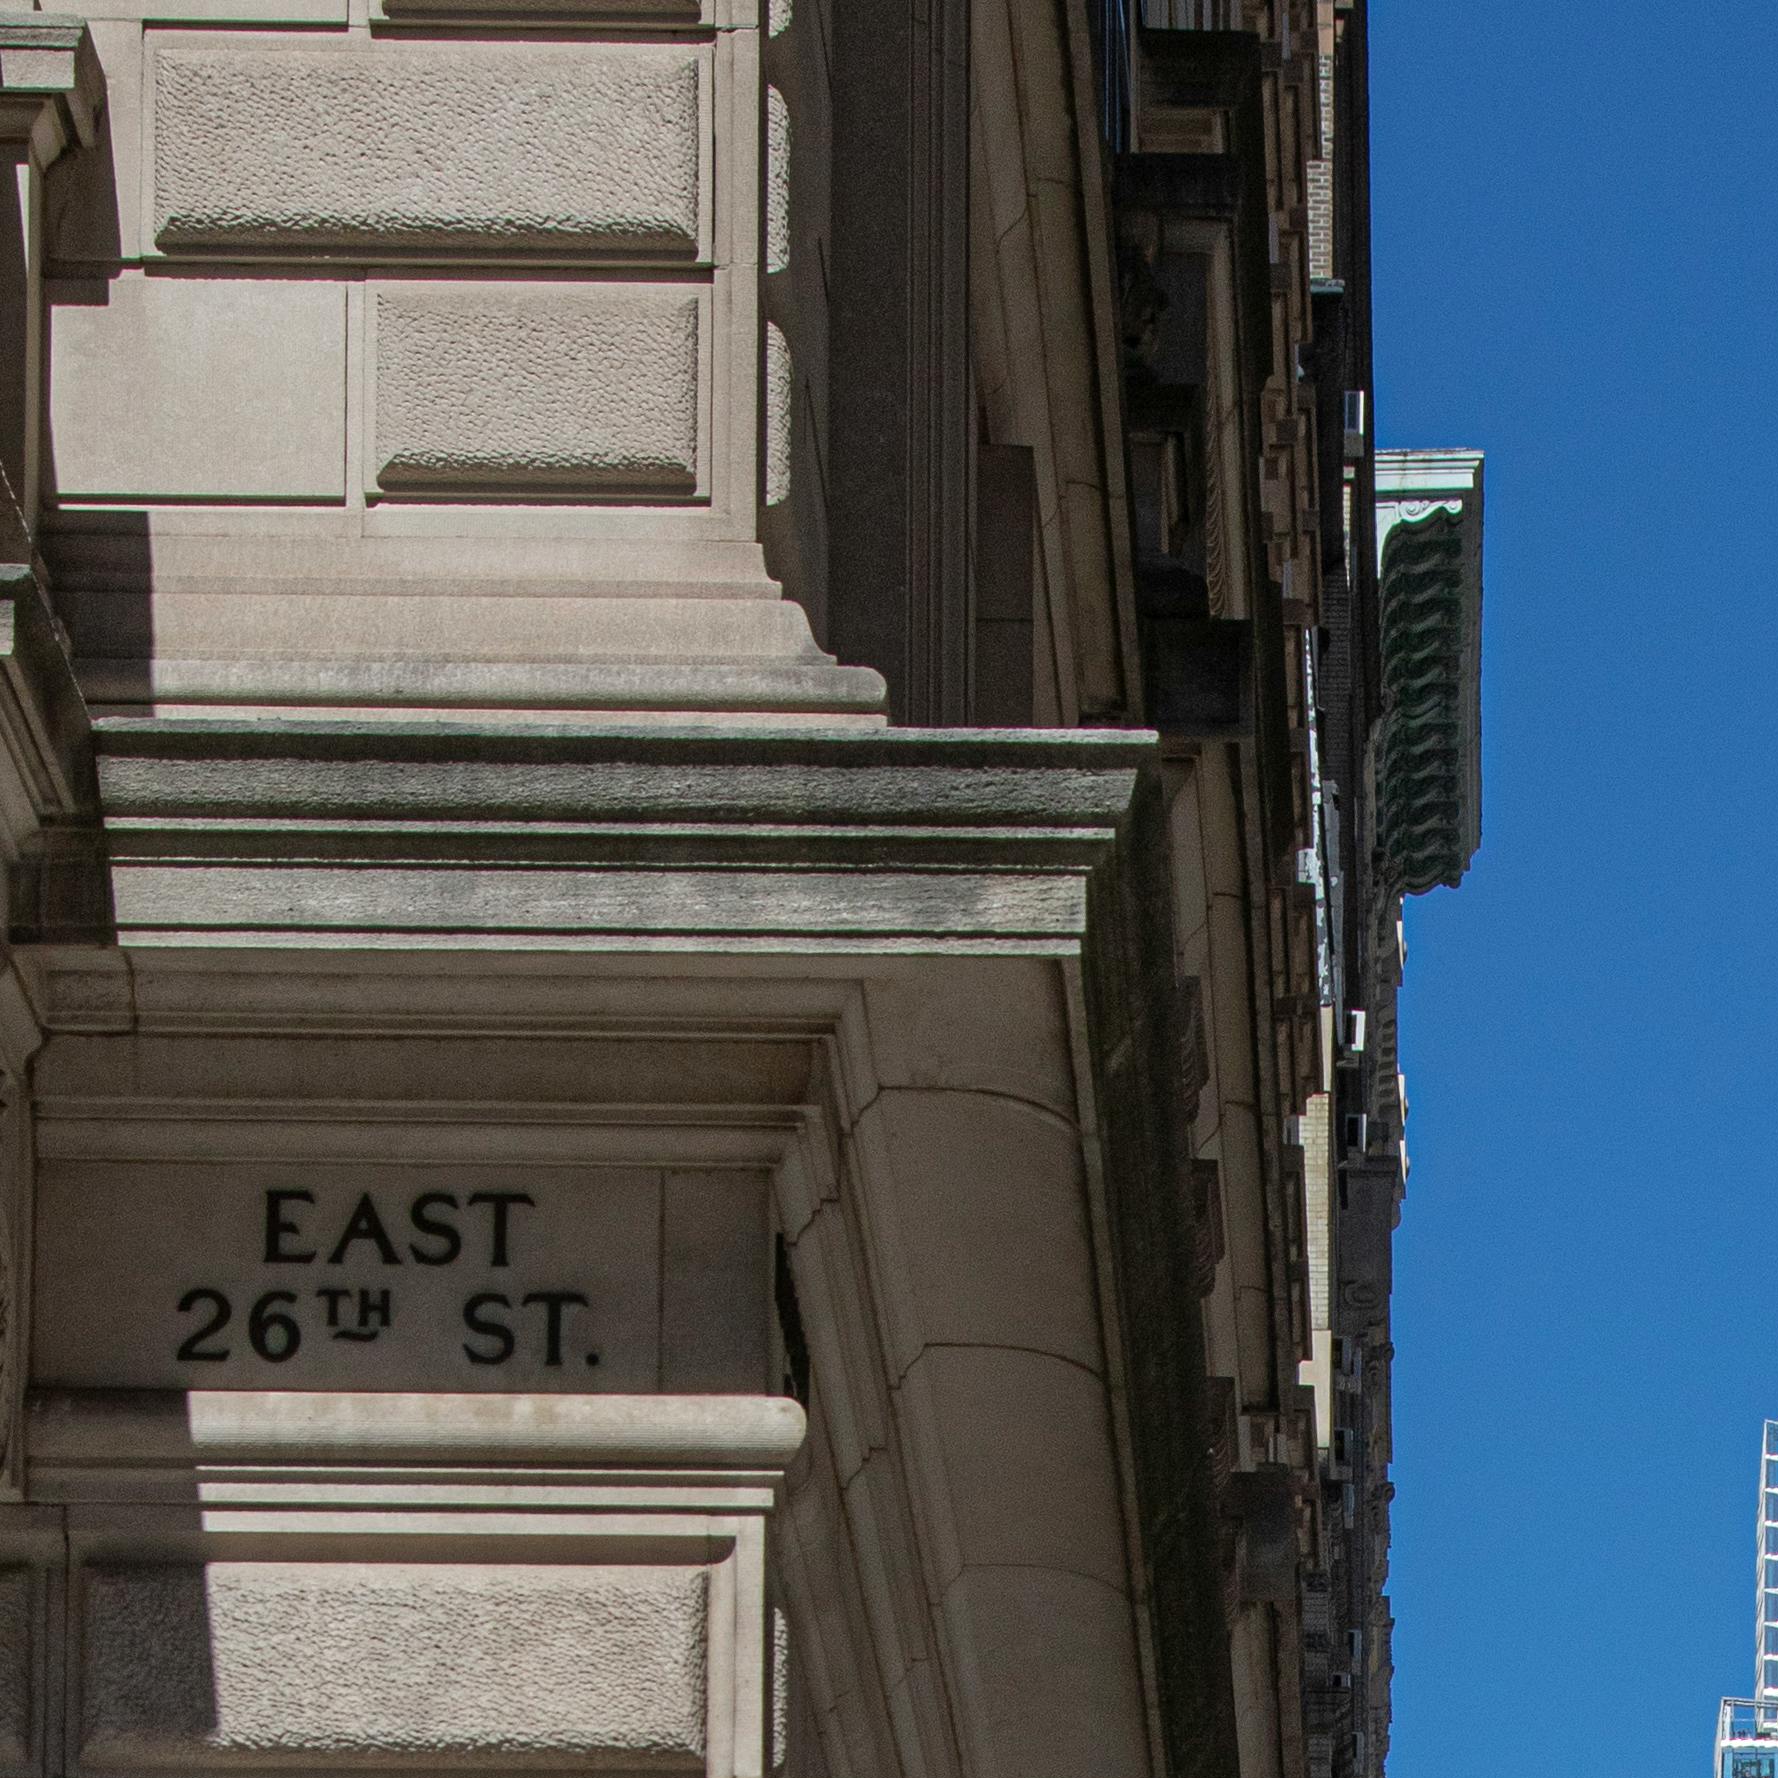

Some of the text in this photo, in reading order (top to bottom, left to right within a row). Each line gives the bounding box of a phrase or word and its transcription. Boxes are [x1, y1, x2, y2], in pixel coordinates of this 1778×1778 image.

[263, 1189, 536, 1267] EAST
[176, 1287, 599, 1367] 26TH ST.
